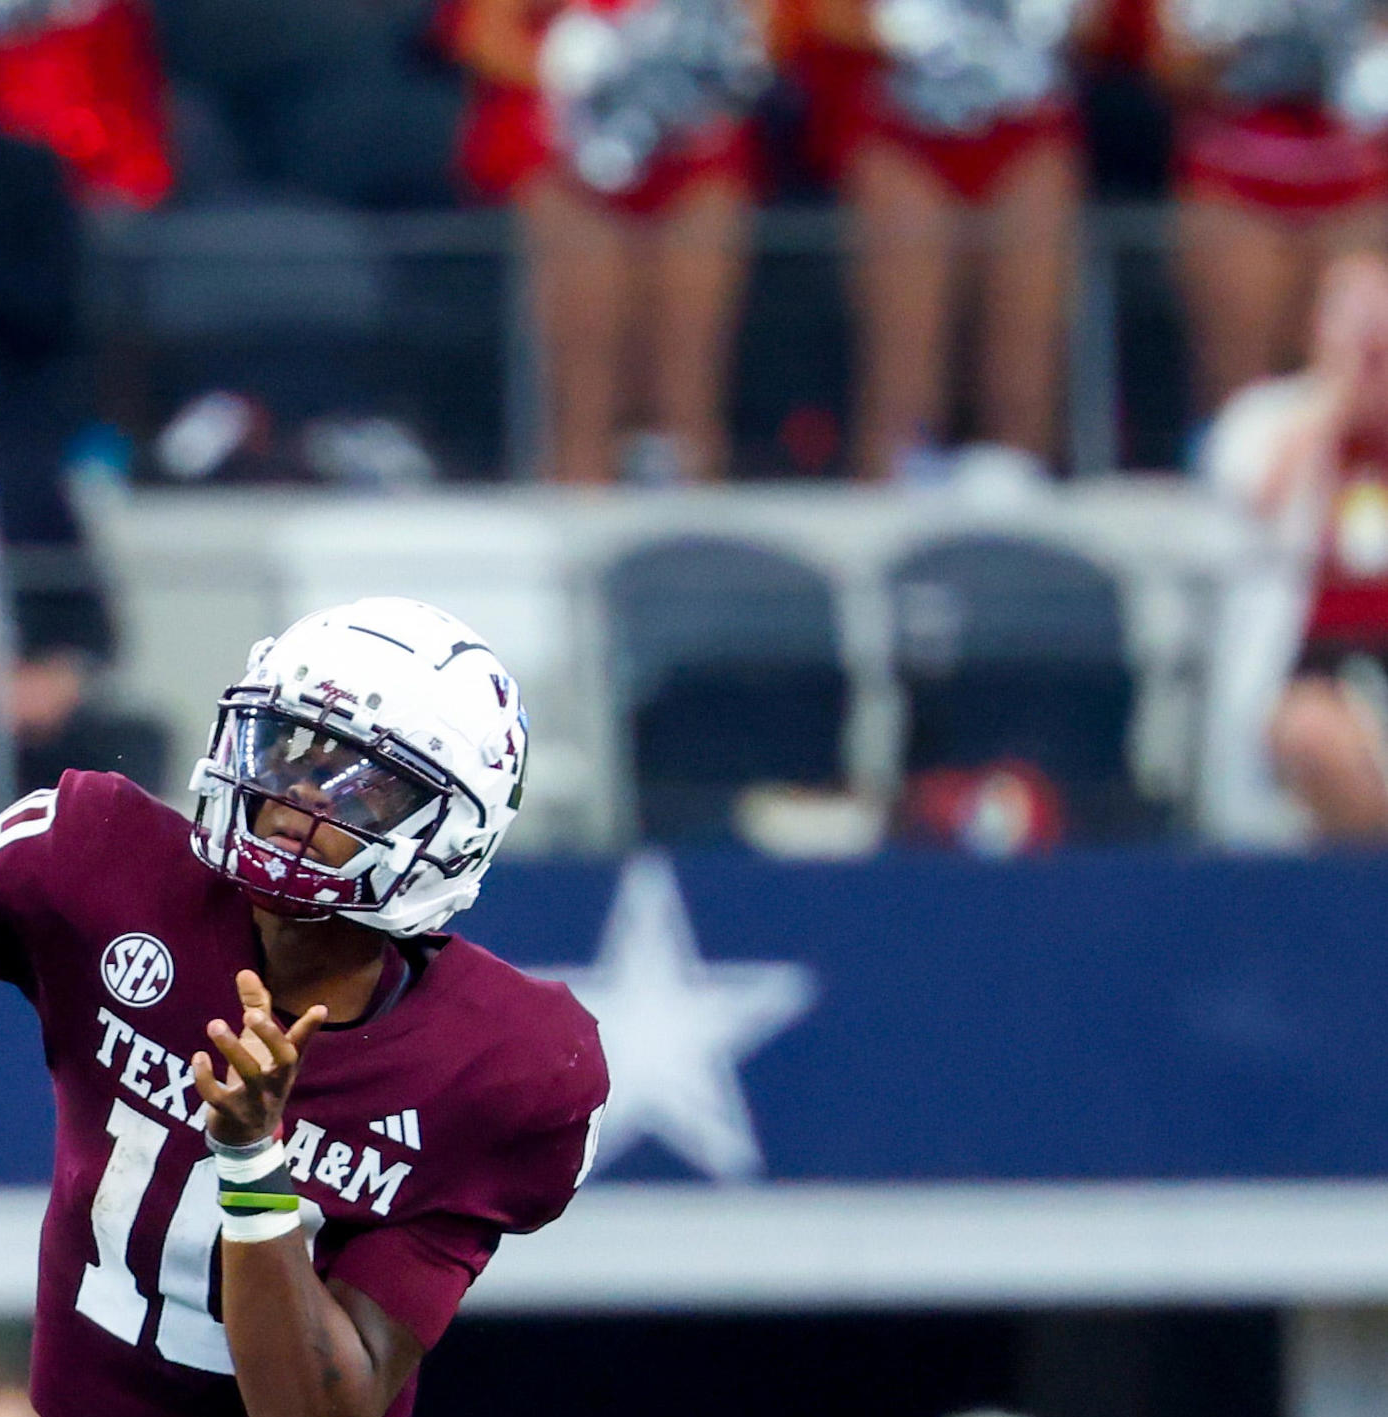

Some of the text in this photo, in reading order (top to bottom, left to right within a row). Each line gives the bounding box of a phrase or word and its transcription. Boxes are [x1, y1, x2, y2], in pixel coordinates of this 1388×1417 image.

[105, 939, 169, 1002] SEC
[96, 1006, 413, 1216] TEX A&M
